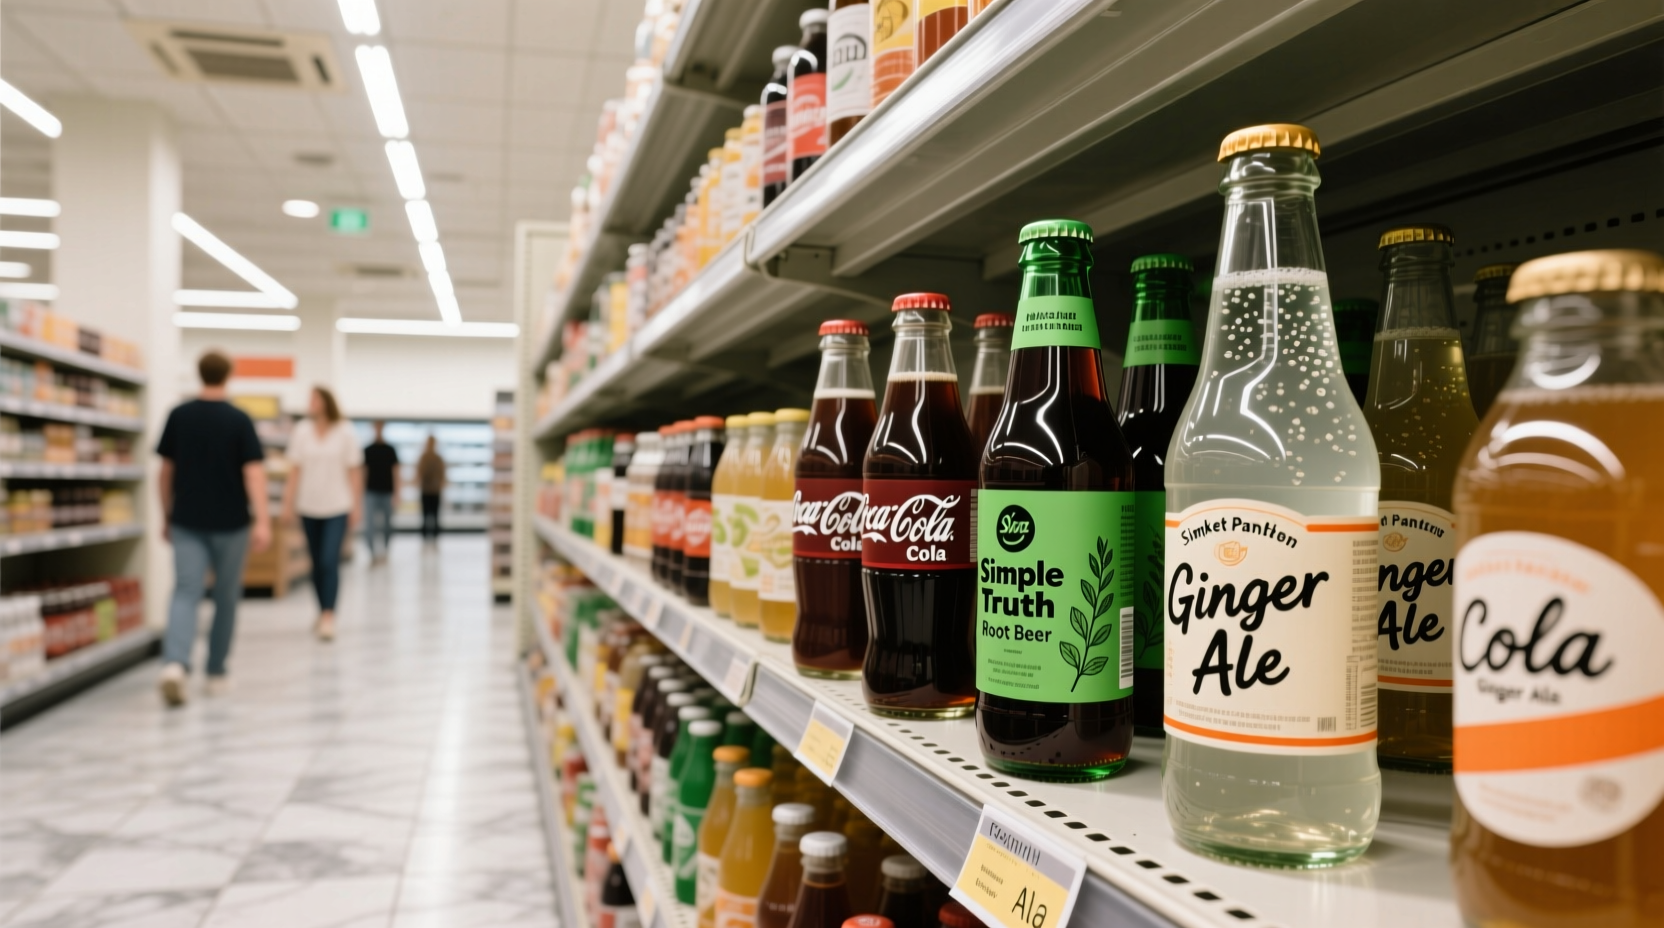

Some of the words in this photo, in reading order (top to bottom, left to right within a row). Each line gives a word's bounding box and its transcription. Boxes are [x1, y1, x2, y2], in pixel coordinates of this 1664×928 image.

[906, 545, 948, 562] Cola
[980, 557, 1065, 593] Simple
[981, 586, 1055, 619] Truth
[1168, 562, 1330, 635] Ginger
[982, 619, 1011, 640] Root
[1014, 624, 1052, 642] Beer
[1378, 600, 1445, 651] Ale
[1460, 597, 1614, 677] Cola
[1192, 628, 1290, 697] Ale
[1011, 885, 1048, 928] Ala
